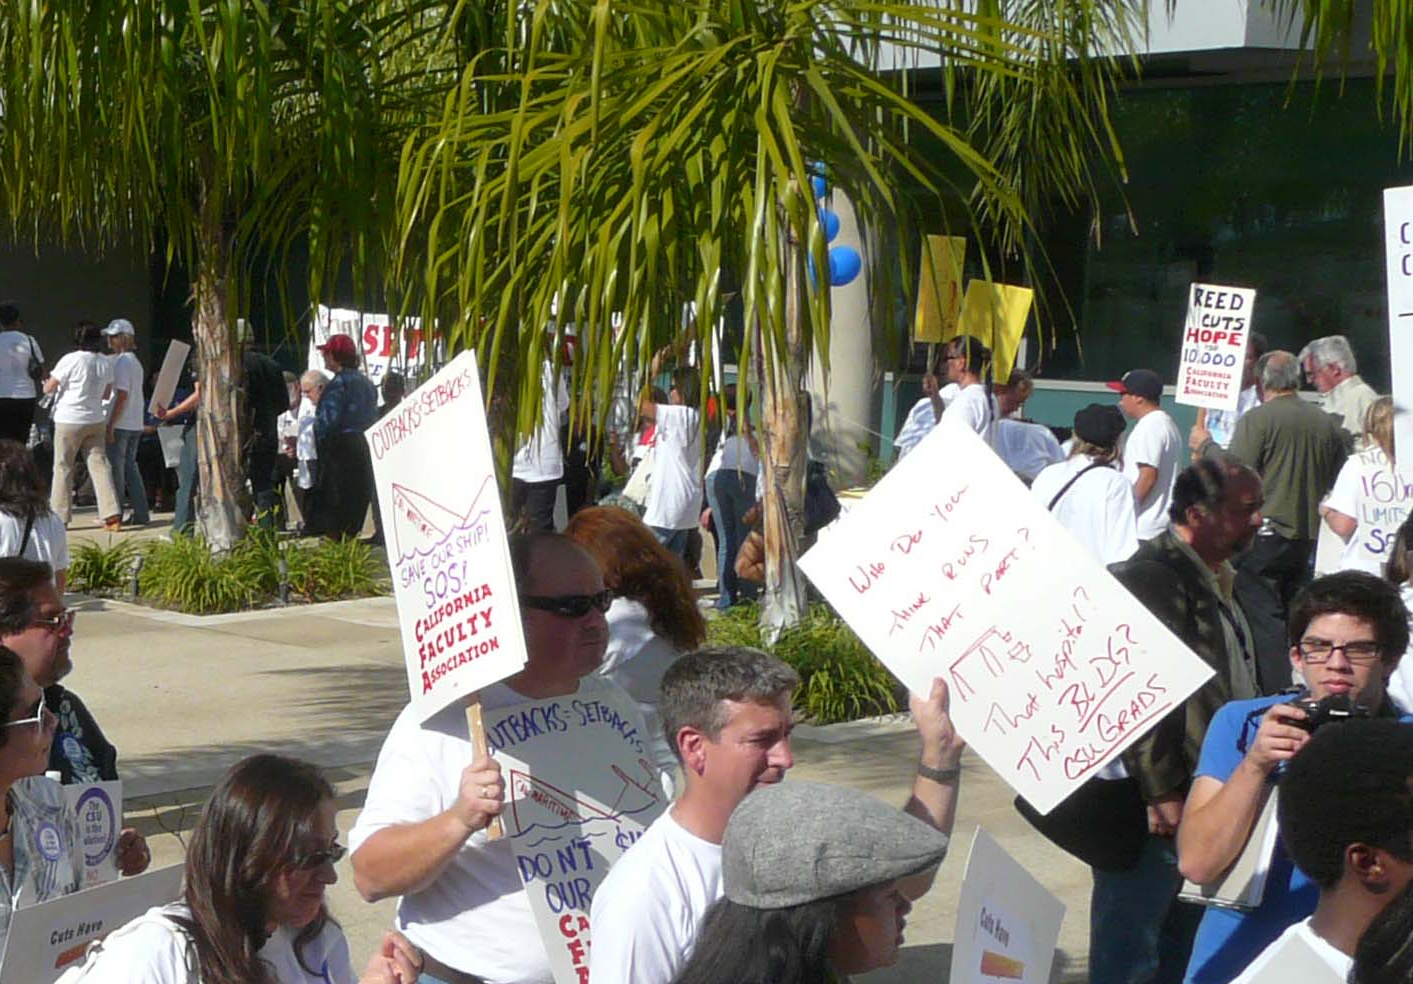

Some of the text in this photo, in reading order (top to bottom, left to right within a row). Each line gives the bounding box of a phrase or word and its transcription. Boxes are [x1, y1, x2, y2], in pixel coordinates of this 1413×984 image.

[1194, 287, 1244, 311] REED
[1186, 327, 1243, 347] HOPE
[1202, 313, 1246, 331] CUTS
[1185, 376, 1230, 390] FACULTY
[401, 559, 425, 588] SAVE
[431, 543, 454, 569] OUR
[423, 560, 468, 609] SOS!
[415, 583, 493, 643] CALIFORNIA
[418, 606, 493, 670] FACULTY
[422, 636, 500, 695] ASSOCIATION
[1097, 673, 1166, 742] GRADS
[517, 838, 594, 882] DON'T
[545, 877, 593, 914] OUR
[50, 919, 103, 945] Cuts Have
[979, 907, 1010, 949] Cuts Have
